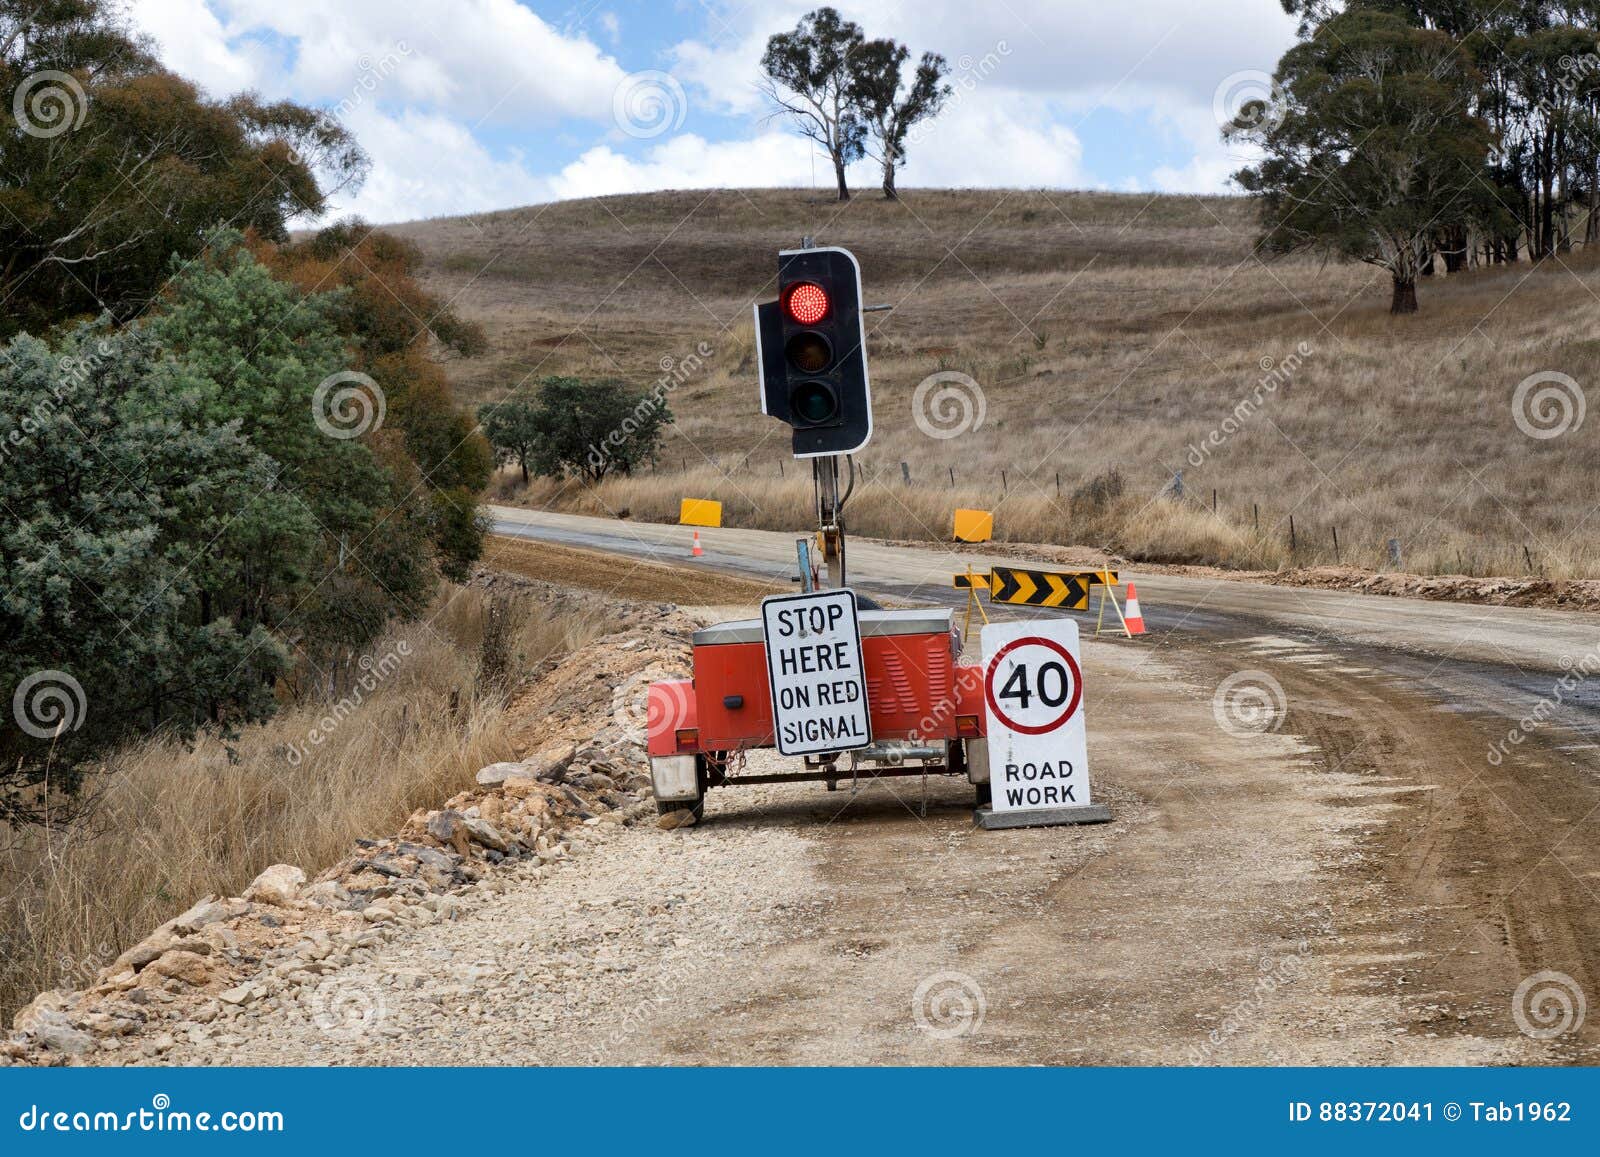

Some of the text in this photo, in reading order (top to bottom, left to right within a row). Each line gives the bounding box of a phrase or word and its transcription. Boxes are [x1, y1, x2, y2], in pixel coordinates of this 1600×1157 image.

[778, 604, 843, 637] STOP
[780, 642, 851, 676] HERE
[780, 680, 859, 710] ON RED
[999, 661, 1069, 709] 40
[784, 714, 865, 744] SIGNAL
[1005, 760, 1073, 782] ROAD
[1006, 785, 1076, 806] WORK
